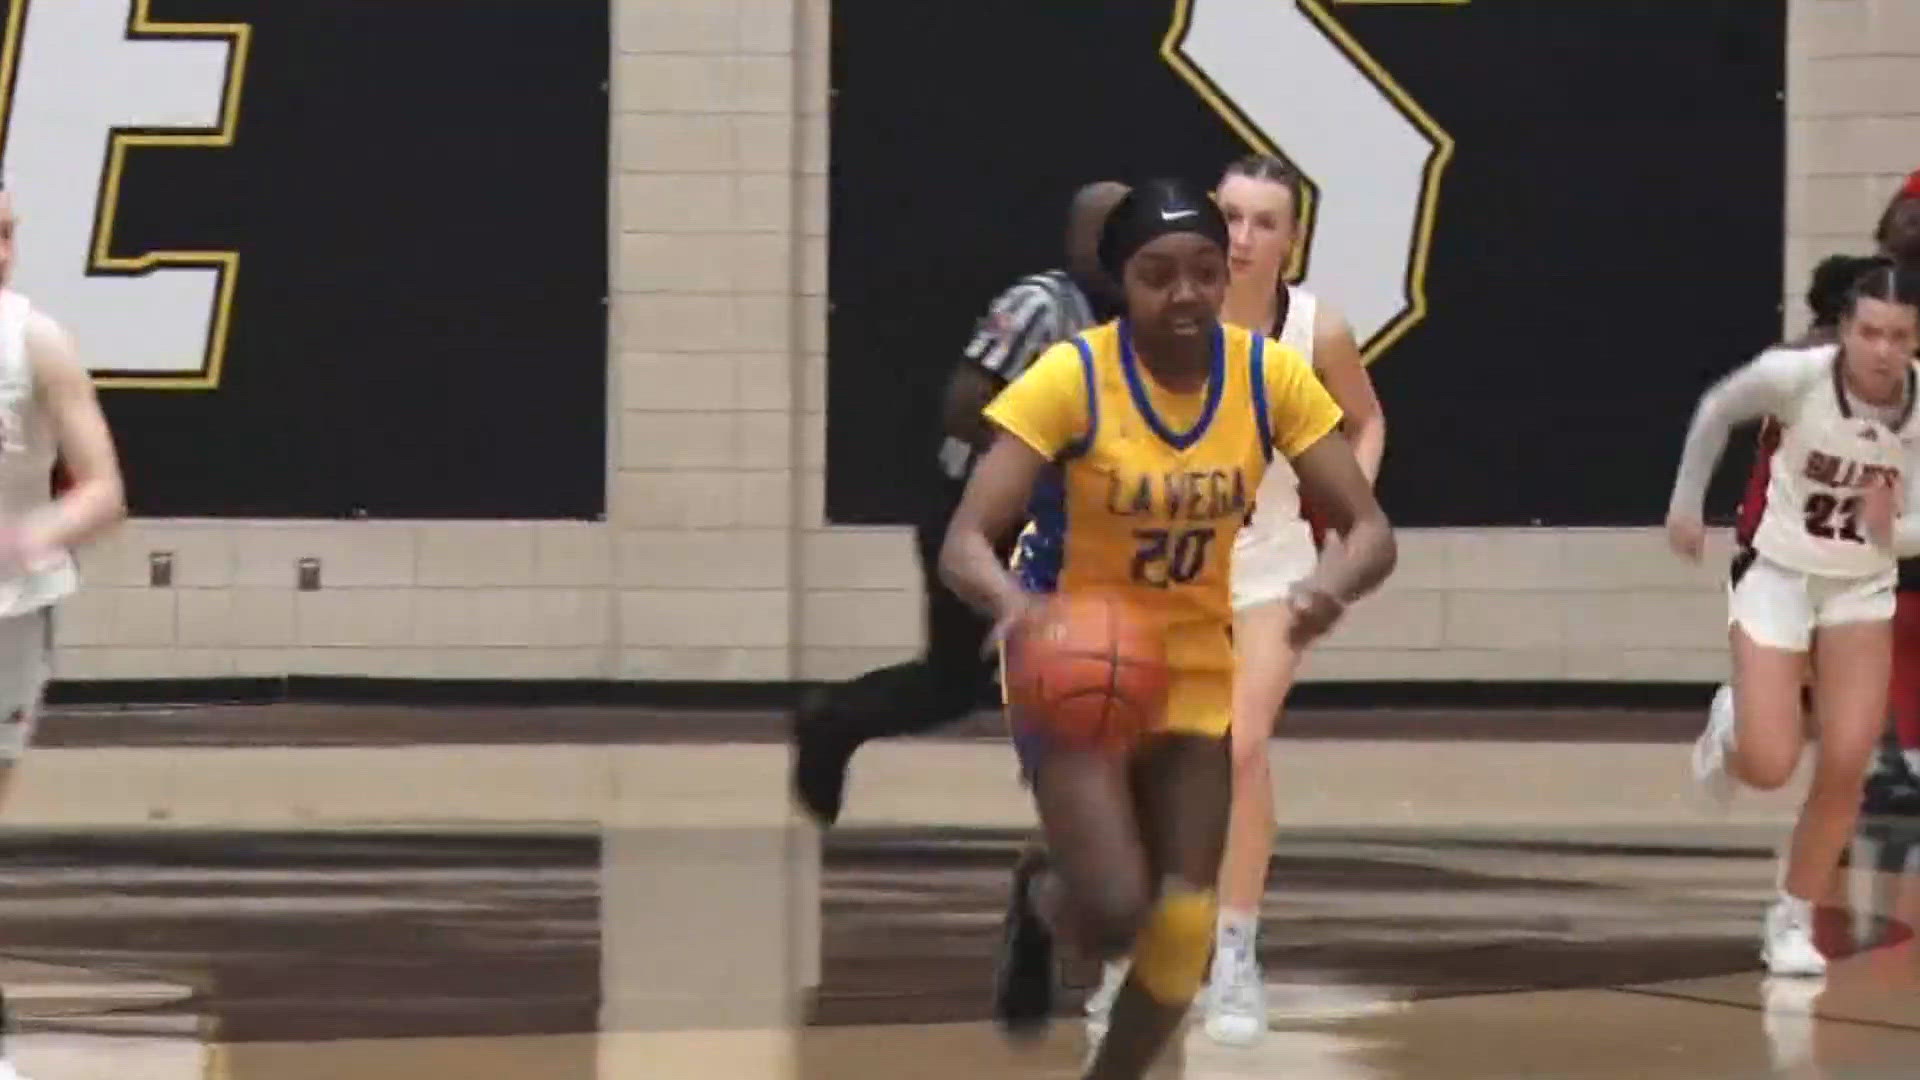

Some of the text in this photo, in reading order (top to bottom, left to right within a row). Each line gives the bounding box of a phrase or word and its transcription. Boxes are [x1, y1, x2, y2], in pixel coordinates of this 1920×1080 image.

[1107, 467, 1246, 520] LA VEGA
[1131, 528, 1215, 588] 20
